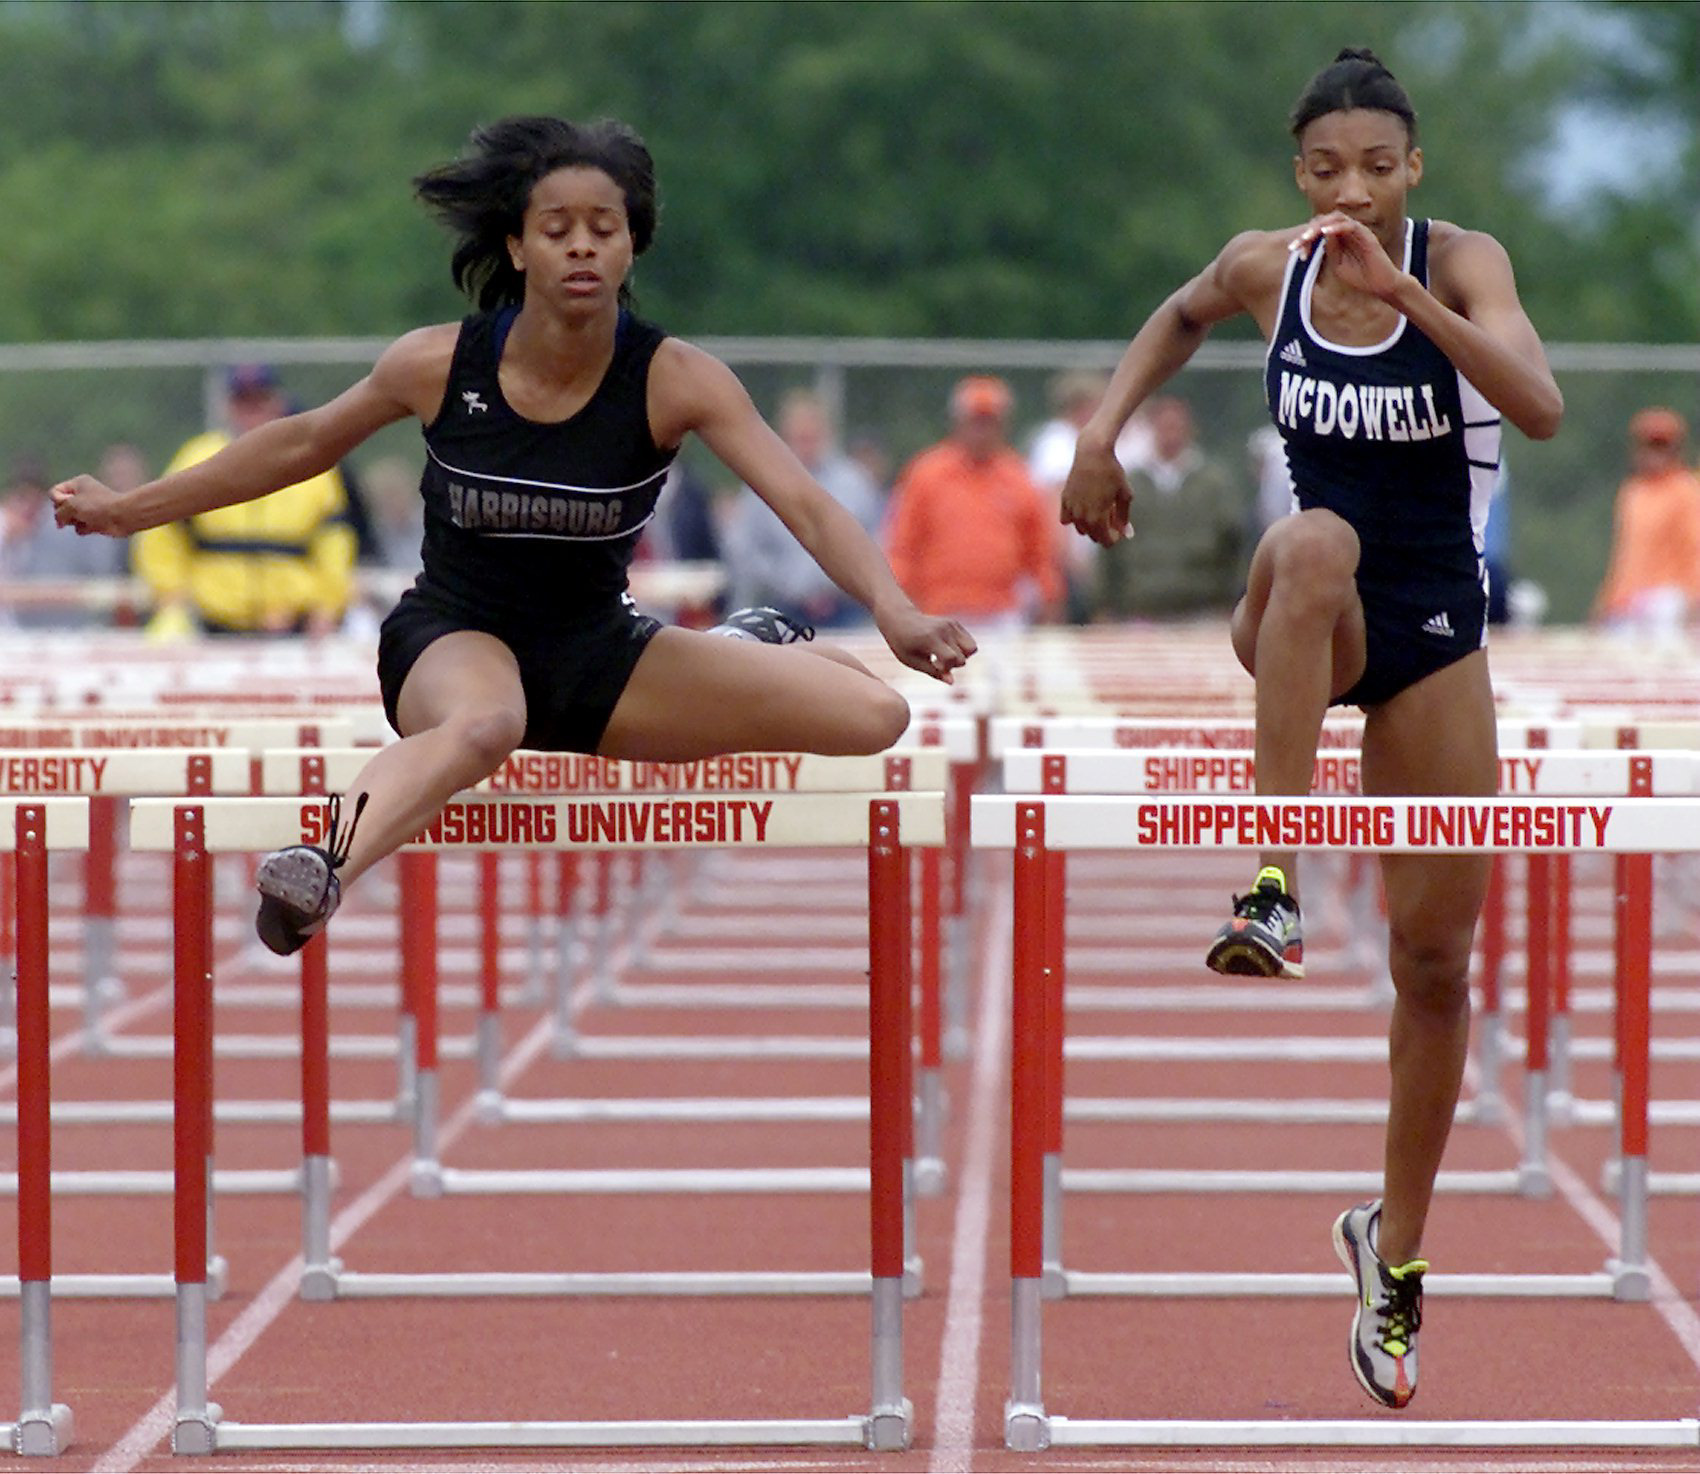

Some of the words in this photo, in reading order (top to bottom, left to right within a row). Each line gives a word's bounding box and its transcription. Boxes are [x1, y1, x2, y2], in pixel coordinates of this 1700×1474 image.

[0, 757, 107, 791] ERSITY
[631, 756, 802, 789] UNIVERSITY
[568, 802, 773, 842] UNIVERSITY
[1138, 805, 1394, 845] SHIPPENSBURG
[1407, 806, 1613, 846] UNIVERSITY
